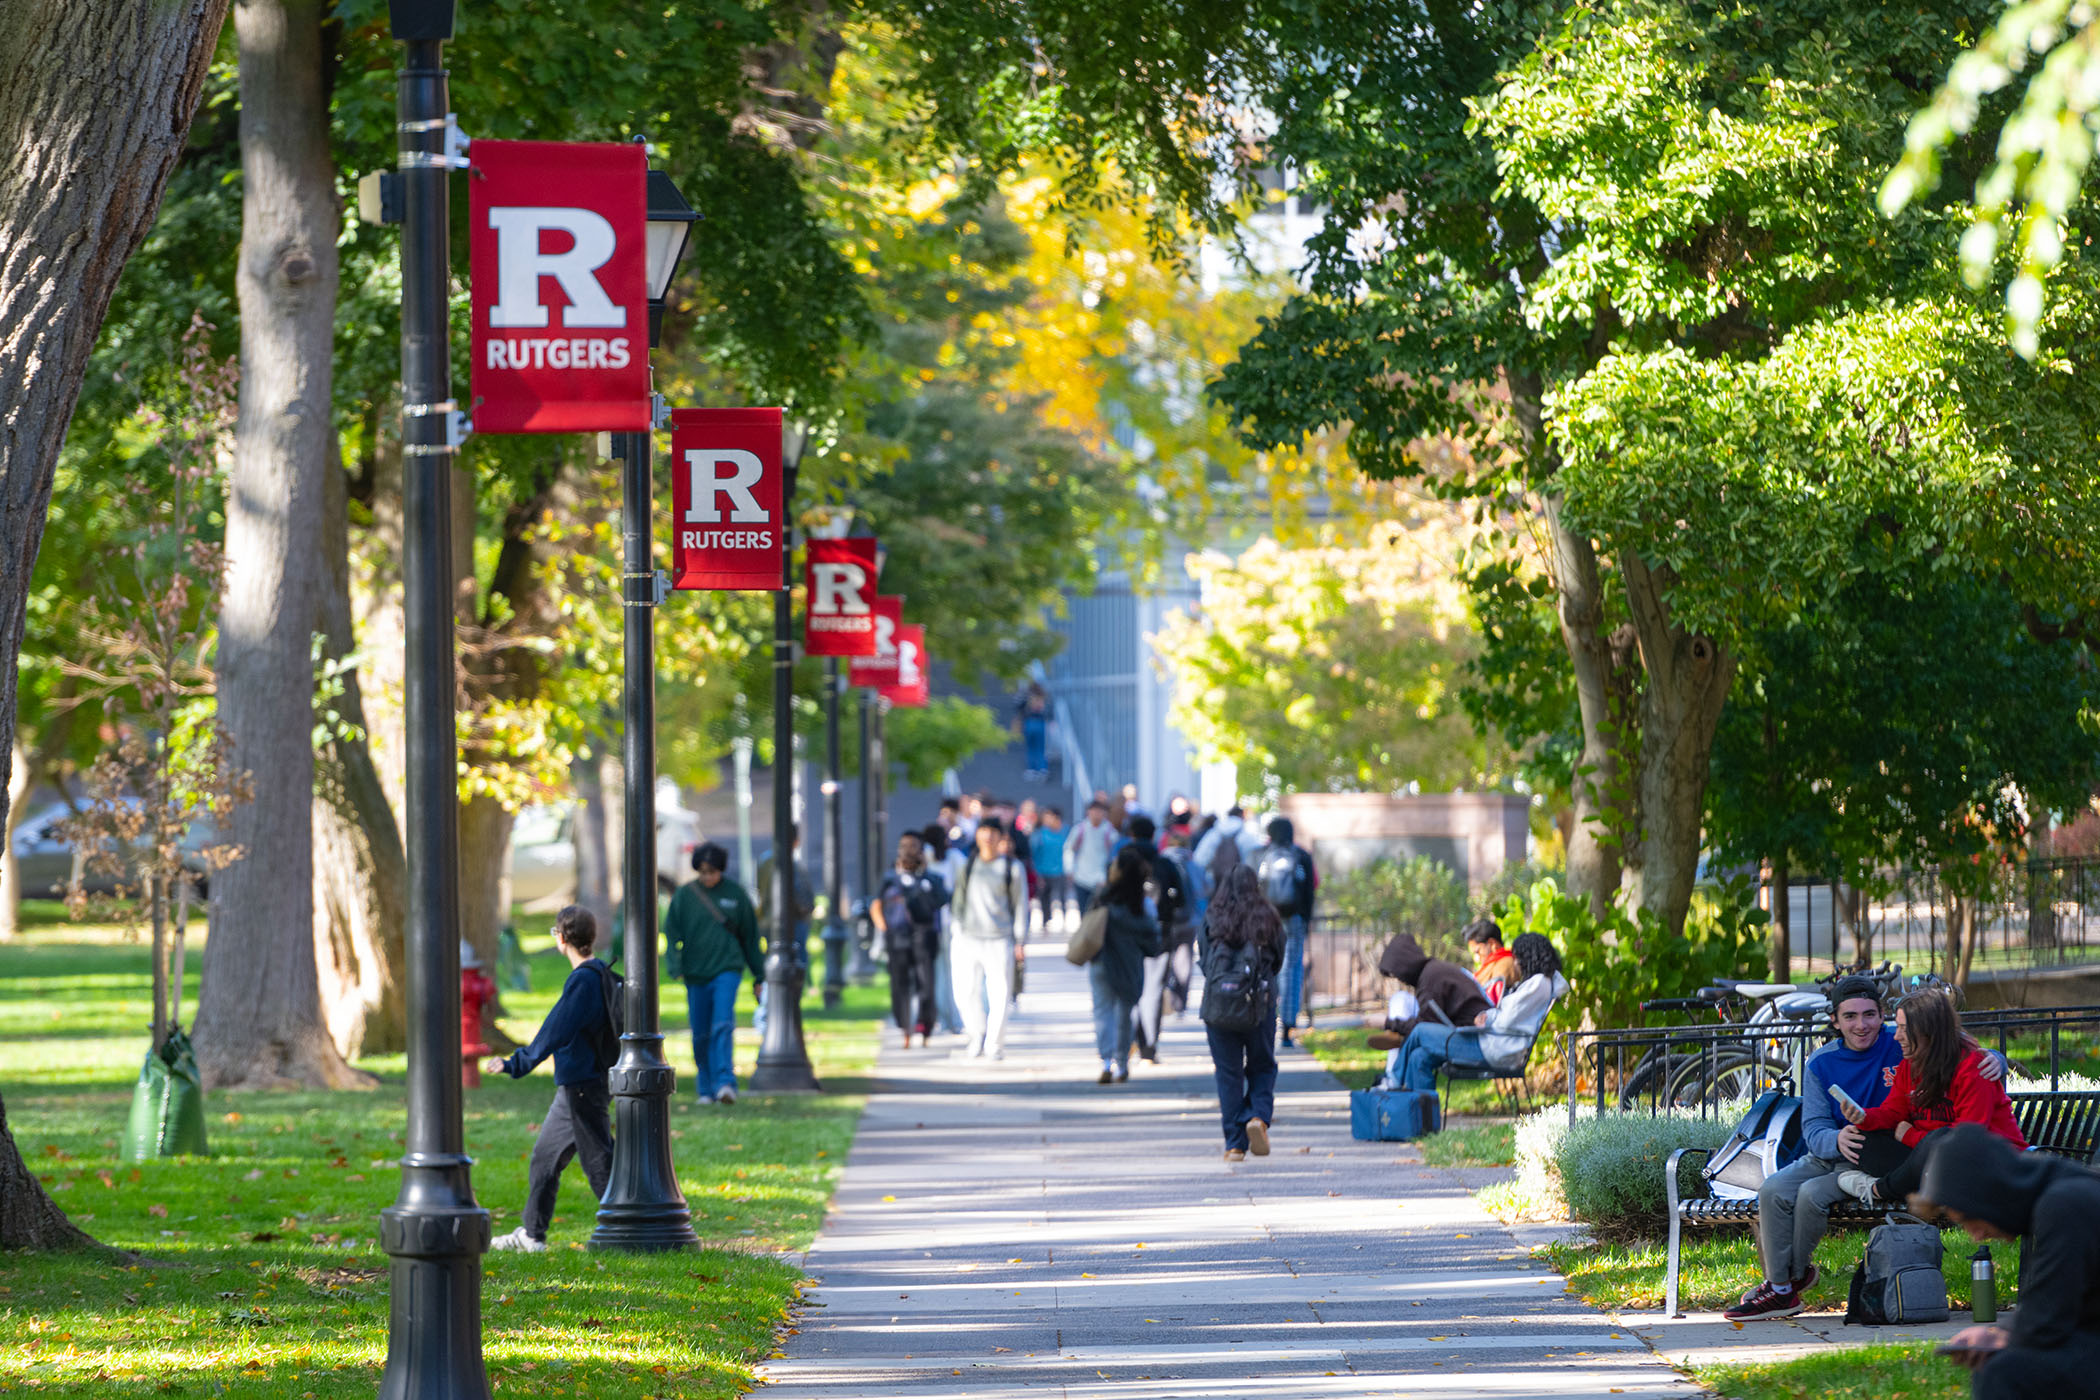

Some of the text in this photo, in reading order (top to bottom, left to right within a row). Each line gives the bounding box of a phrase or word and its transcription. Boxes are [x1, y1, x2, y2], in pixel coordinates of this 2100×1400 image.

[488, 206, 627, 328] R
[487, 338, 631, 369] RUTGERS
[684, 448, 770, 523] R
[682, 531, 773, 549] RUTGERS
[812, 563, 870, 614] R
